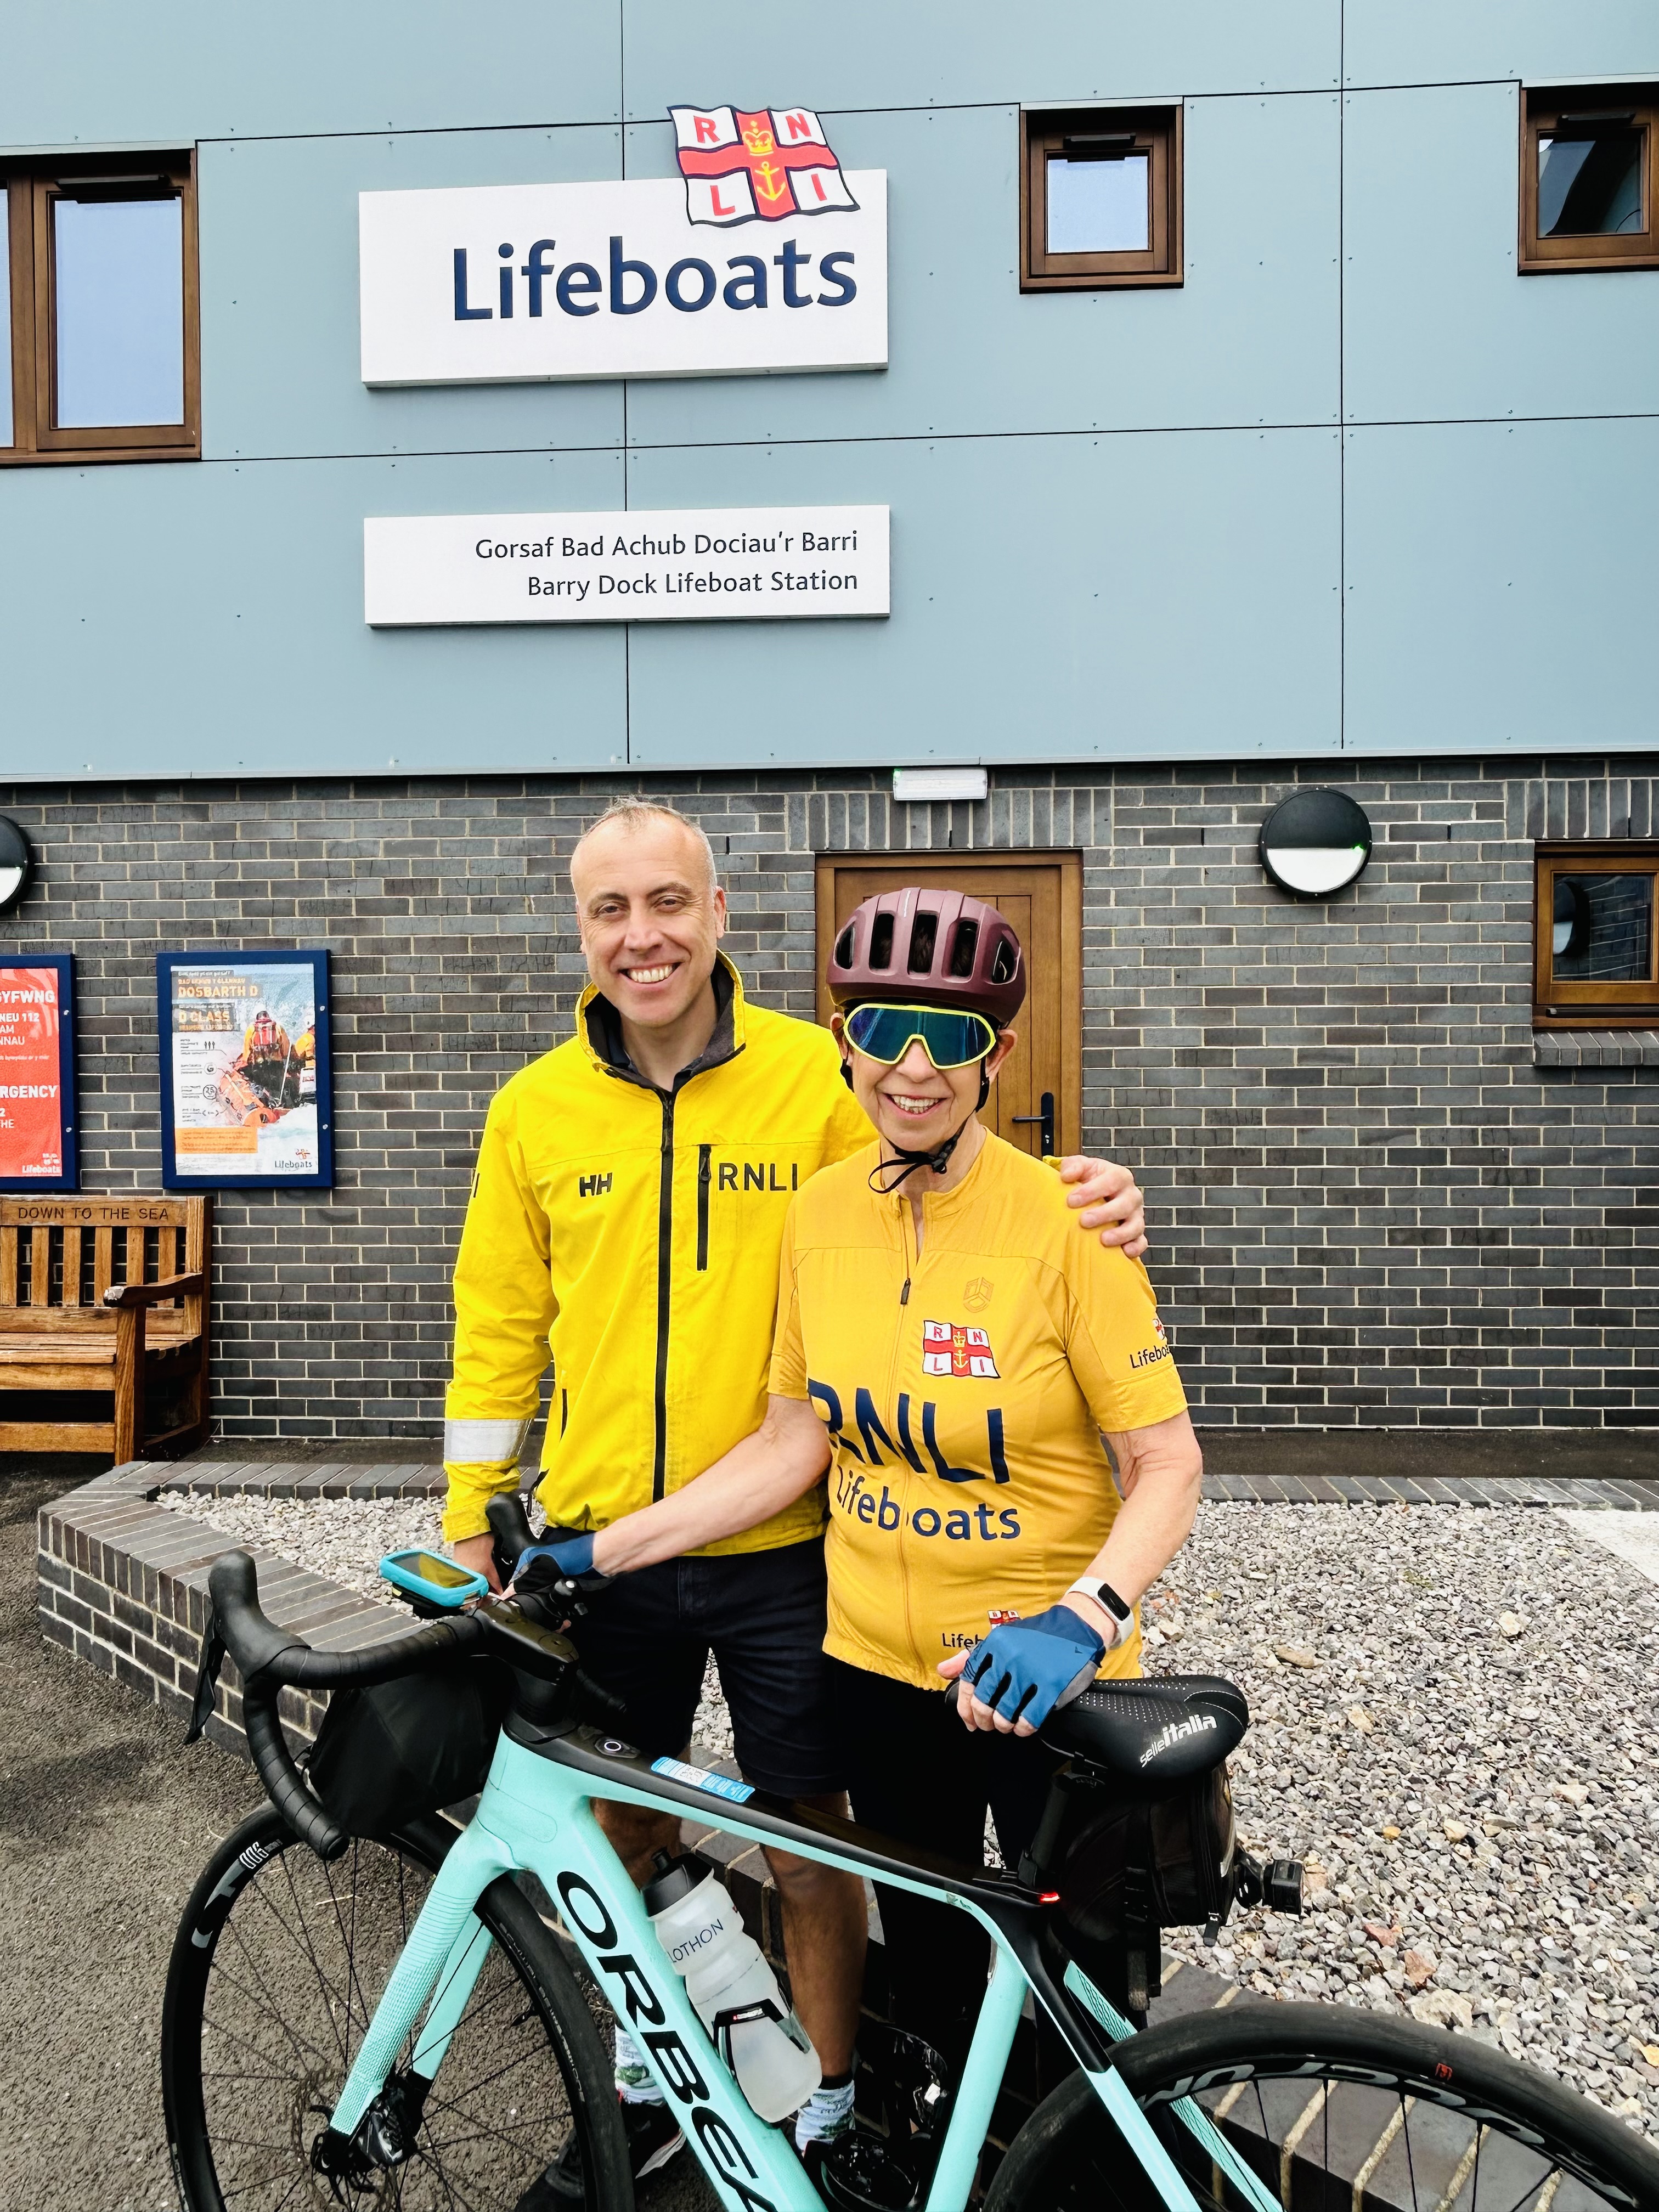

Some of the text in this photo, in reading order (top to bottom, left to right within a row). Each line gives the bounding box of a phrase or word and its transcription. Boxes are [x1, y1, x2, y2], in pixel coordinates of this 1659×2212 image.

[694, 112, 811, 144] R N
[709, 173, 827, 217] L I
[453, 235, 857, 320] Lifeboats
[475, 530, 858, 560] Gorsaf Bad Achub Dociau'r Barri
[528, 570, 858, 601] Barry Dock Lifeboat Station
[0, 990, 55, 1004] YFWNG
[178, 985, 258, 998] DOSBARTH D
[22, 1012, 40, 1023] 112
[190, 1010, 230, 1023] CLASS
[719, 1163, 798, 1191] RNLI
[18, 1207, 168, 1220] DOWN TO THE SEA
[808, 1378, 1011, 1485] RNLI
[836, 1464, 1022, 1541] Lifeboats
